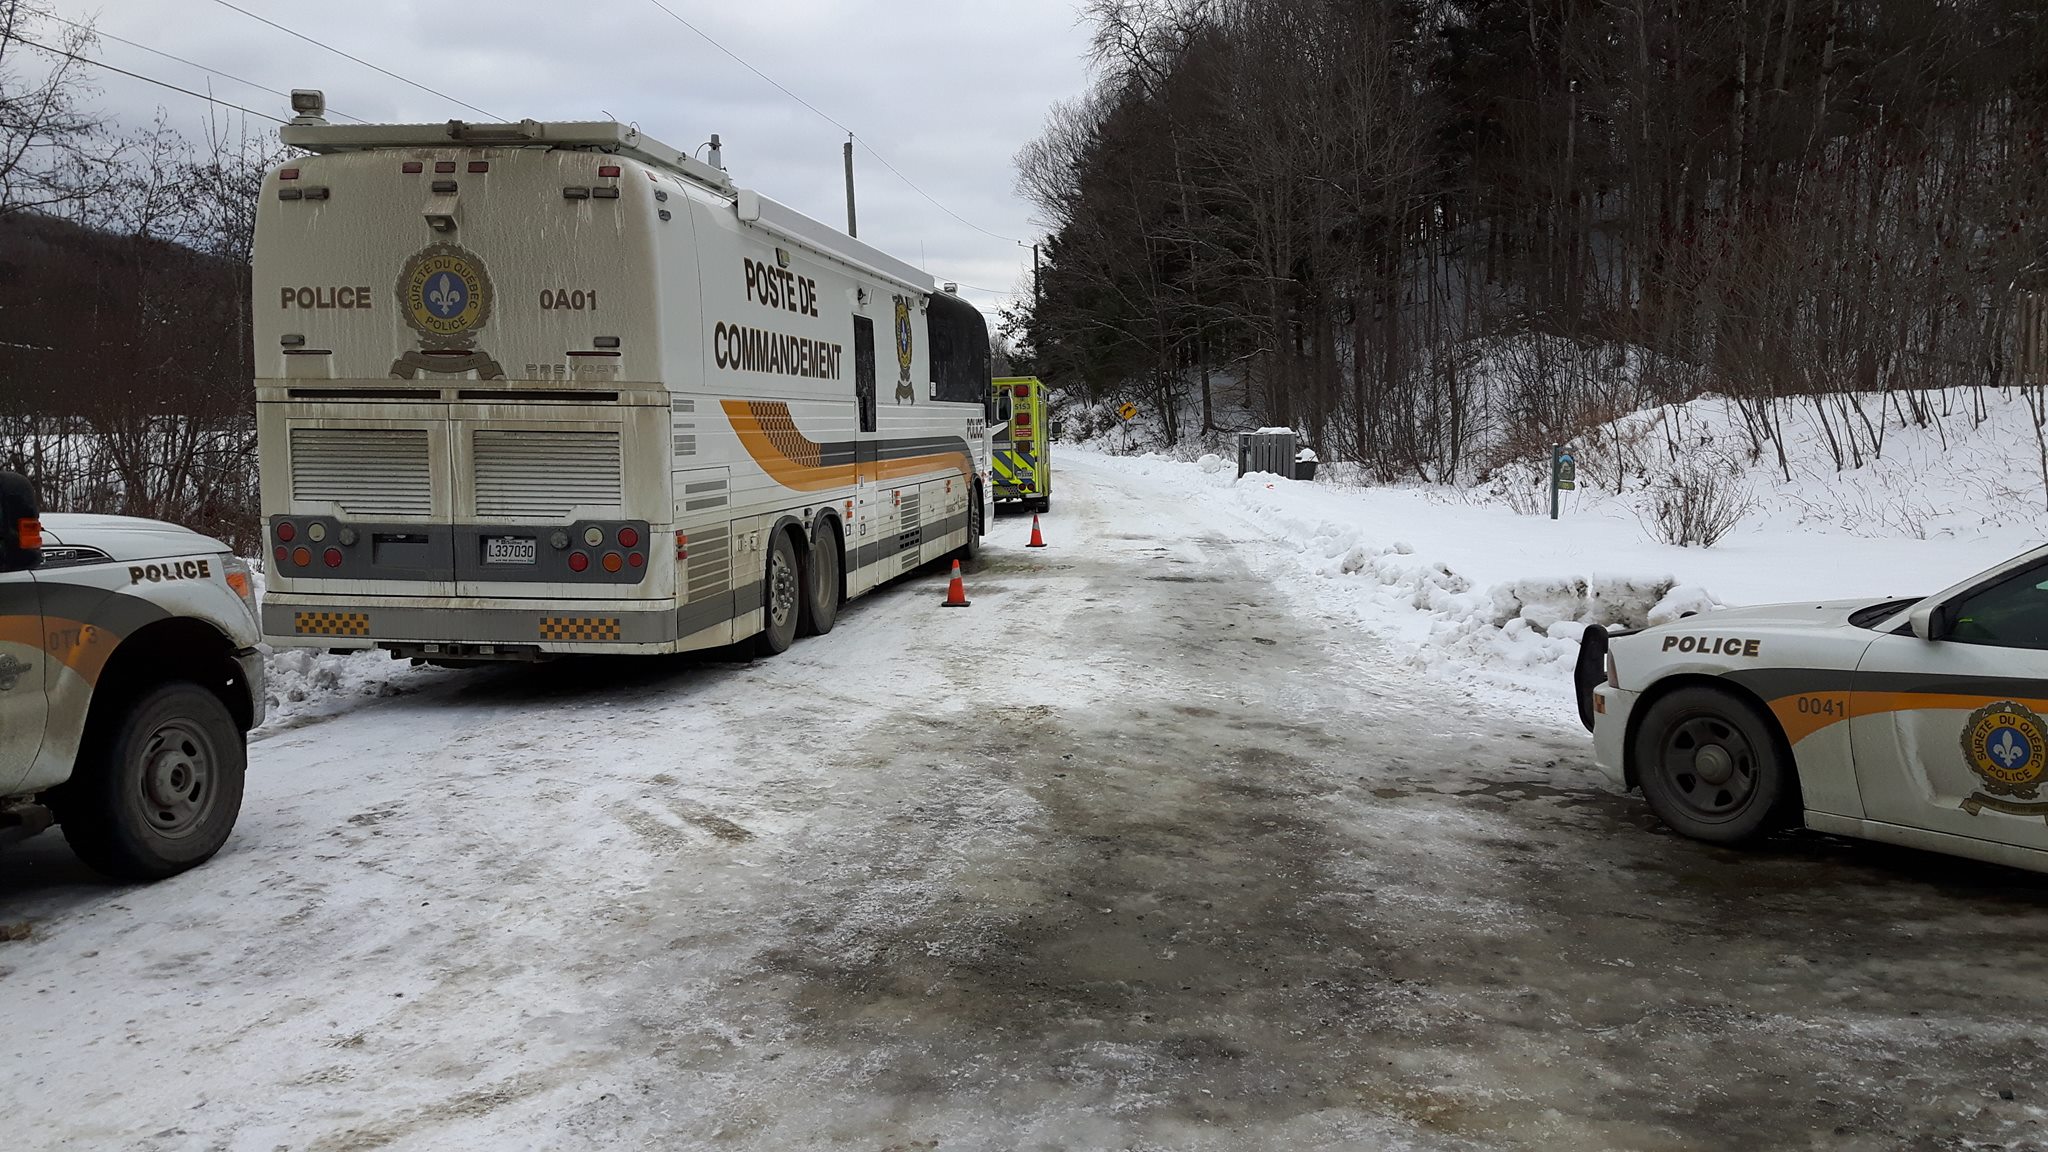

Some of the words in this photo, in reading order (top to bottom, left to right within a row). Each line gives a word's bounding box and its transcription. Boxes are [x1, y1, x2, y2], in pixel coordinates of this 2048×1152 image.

[434, 260, 451, 269] DU
[281, 286, 372, 309] POLICE
[744, 257, 797, 312] POSTE
[798, 275, 818, 317] DE
[540, 288, 596, 310] 0A01
[425, 316, 467, 330] POLICE
[714, 321, 842, 380] COMMANDEMENT
[489, 545, 533, 557] L337030
[128, 560, 211, 585] POLICE
[1662, 635, 1761, 658] POLICE
[1797, 696, 1844, 717] 0041
[2000, 715, 2015, 725] DU
[1987, 764, 2032, 781] POLICE
